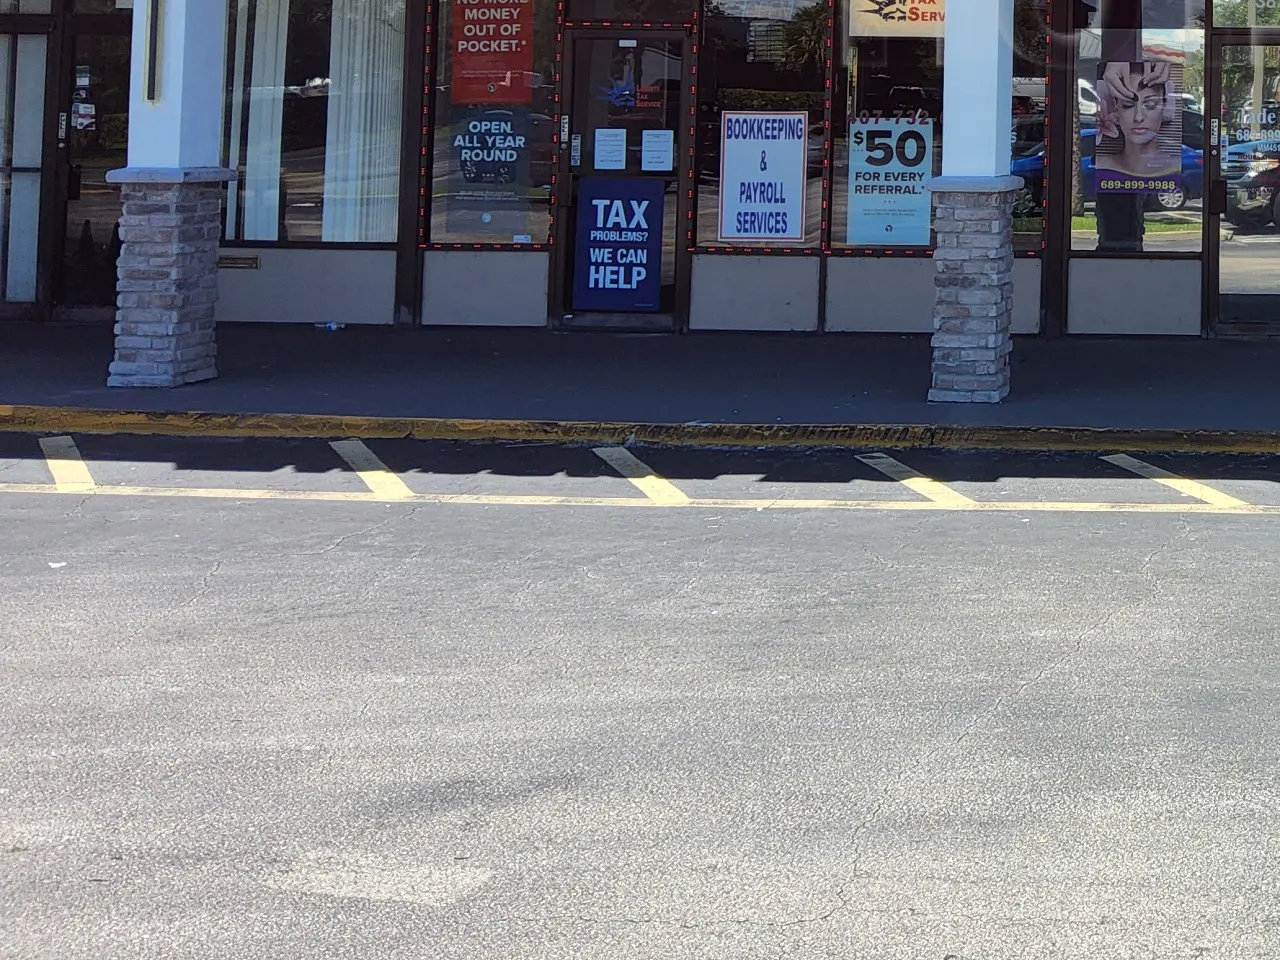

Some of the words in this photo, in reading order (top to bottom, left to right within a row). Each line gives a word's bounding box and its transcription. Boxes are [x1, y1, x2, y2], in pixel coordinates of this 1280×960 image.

[464, 7, 521, 20] MONEY
[907, 6, 946, 22] SERV
[463, 24, 497, 37] OUT
[500, 23, 521, 36] OF
[1236, 107, 1276, 124] Jade
[468, 121, 512, 133] OPEN
[726, 118, 803, 140] BOOKKEEPING
[453, 135, 481, 147] ALL
[485, 135, 526, 148] YEAR
[853, 129, 927, 168] $50
[461, 149, 518, 162] ROUND
[759, 149, 768, 172] &
[855, 171, 881, 182] FOR
[884, 171, 925, 182] EVERY
[1100, 180, 1176, 189] 689-899-9988
[739, 182, 786, 204] PAYROLL
[591, 199, 649, 229] TAX
[736, 211, 788, 234] SERVICES
[590, 230, 649, 242] PROBLEMS?
[589, 248, 613, 264] WE
[617, 248, 647, 264] CAN
[588, 266, 647, 290] HELP
